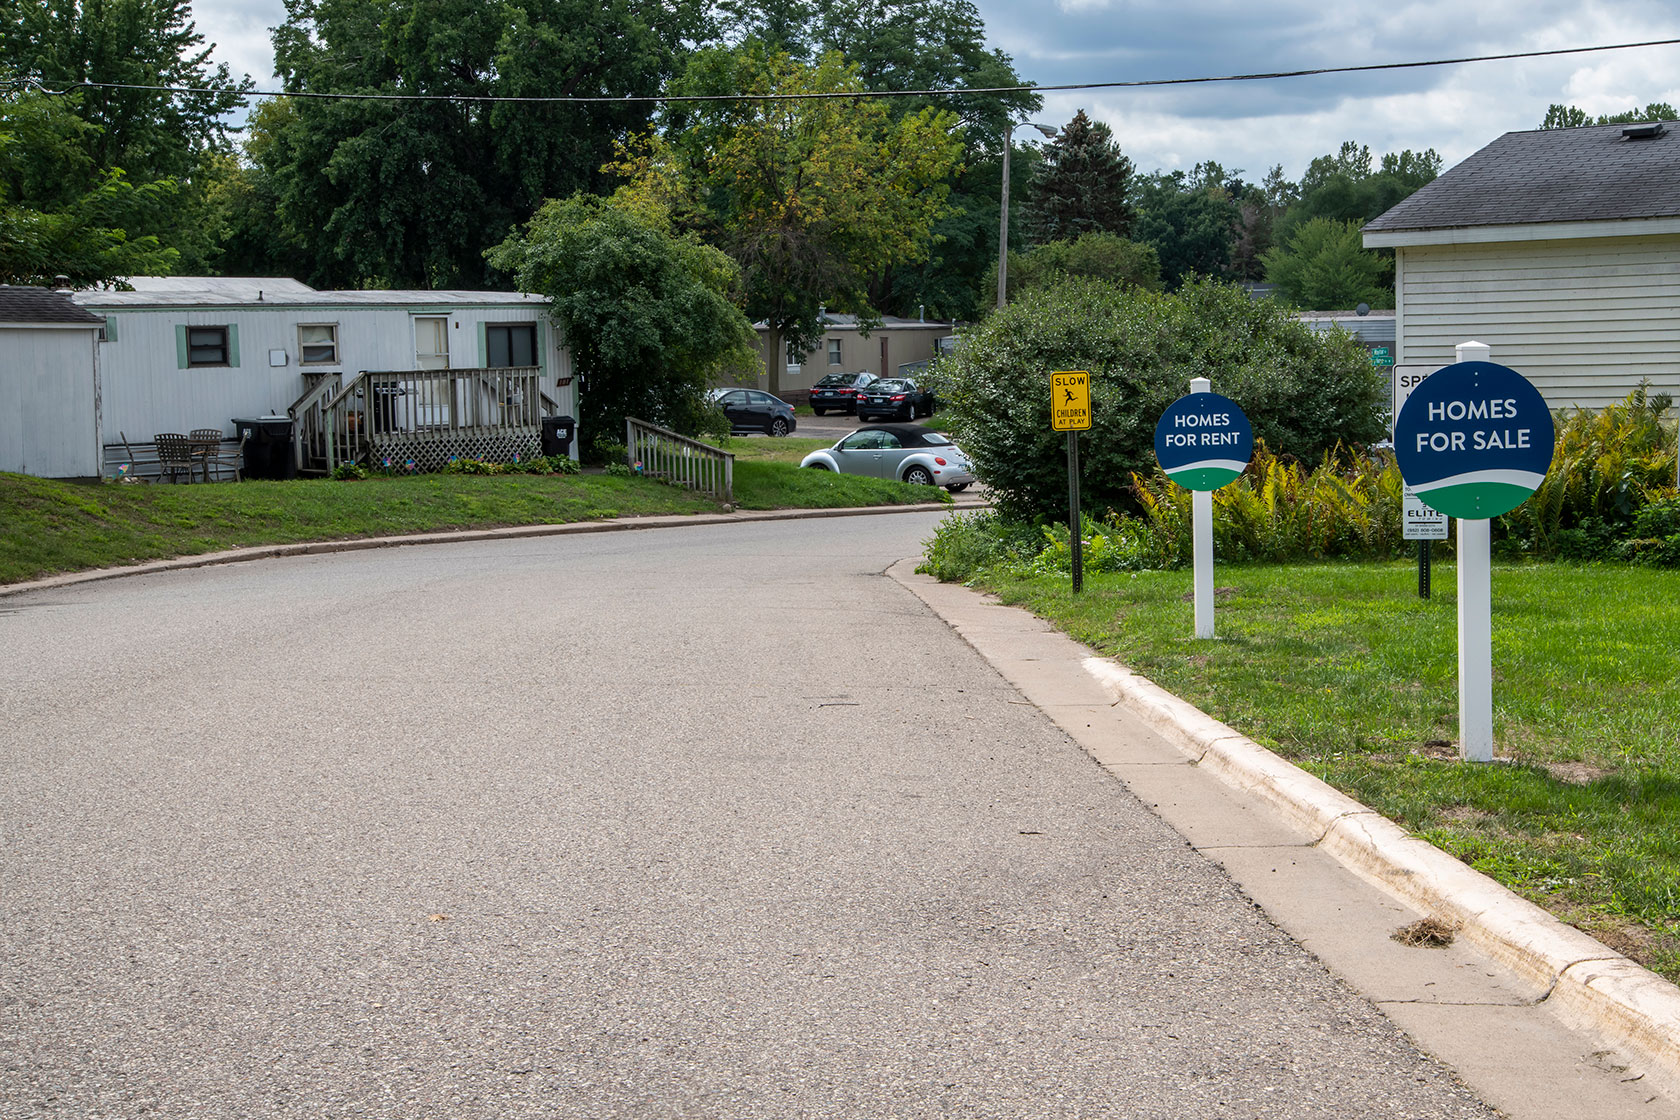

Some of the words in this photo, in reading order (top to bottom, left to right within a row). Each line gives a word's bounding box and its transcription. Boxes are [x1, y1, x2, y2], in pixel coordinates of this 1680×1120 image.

[1055, 377, 1085, 386] SLOW
[1056, 409, 1087, 418] CHILDREN
[1428, 398, 1518, 422] HOMES
[1174, 413, 1230, 428] HOMES
[1165, 433, 1197, 447] FOR
[1201, 431, 1241, 446] RENT
[1416, 431, 1466, 453] FOR
[1473, 428, 1531, 451] SALE
